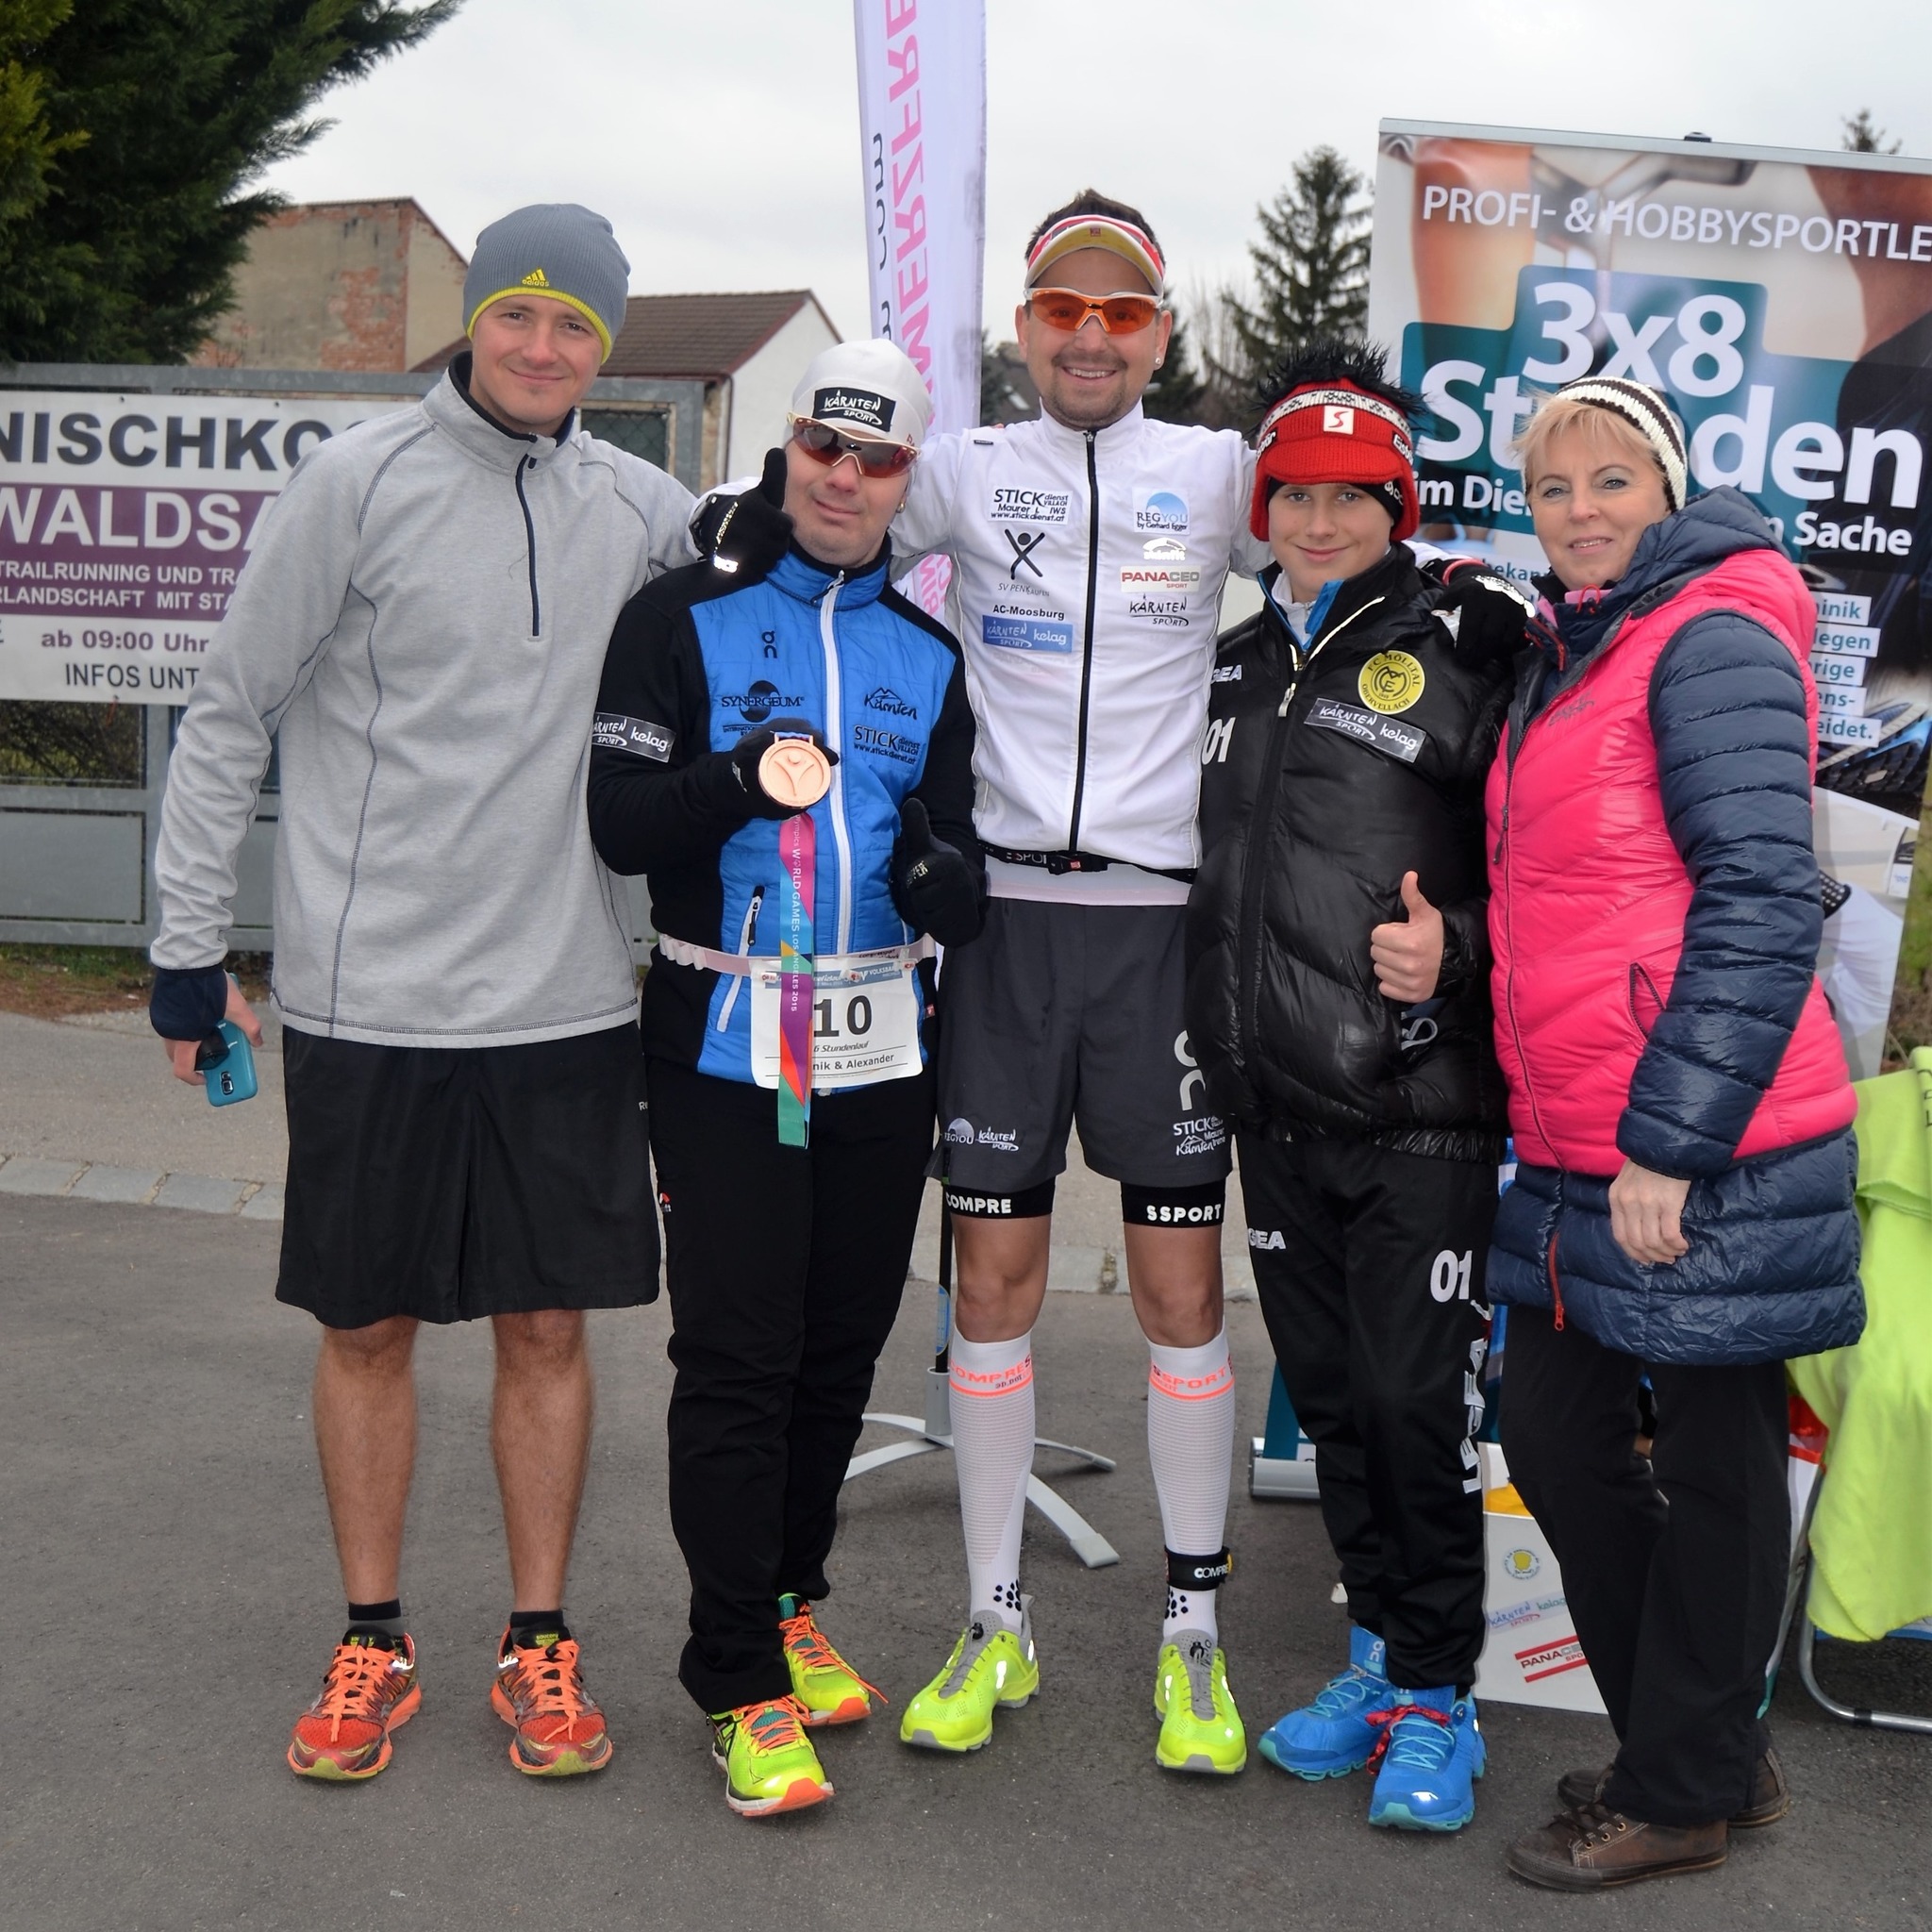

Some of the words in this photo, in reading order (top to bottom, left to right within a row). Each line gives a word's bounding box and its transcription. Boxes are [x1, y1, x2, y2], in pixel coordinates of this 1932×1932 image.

[1423, 186, 1557, 229] PROFI-
[1564, 197, 1596, 234] &
[1522, 282, 1746, 398] 3x8
[993, 489, 1045, 508] STICK
[1792, 510, 1913, 556] Sache
[158, 567, 203, 585] UND
[998, 582, 1008, 591] SV
[1122, 571, 1201, 582] PANACEO
[157, 591, 193, 609] MIT
[992, 605, 1065, 621] AC-Moosburg
[41, 629, 73, 648] ab
[82, 630, 154, 651] 09:00
[163, 633, 209, 653] Uhr
[1033, 627, 1067, 645] kelag
[65, 663, 141, 688] INFOS
[630, 725, 669, 753] kelag
[854, 725, 900, 752] STICK
[1202, 717, 1236, 765] 01
[1379, 723, 1417, 750] kelag
[791, 890, 801, 932] GAMES
[791, 933, 799, 950] LOS
[814, 995, 873, 1037] 10
[834, 1059, 842, 1070] &
[846, 1054, 894, 1069] Alexander
[1173, 1117, 1213, 1136] STICK
[1146, 1204, 1222, 1223] SSPORT
[1430, 1250, 1473, 1303] 01
